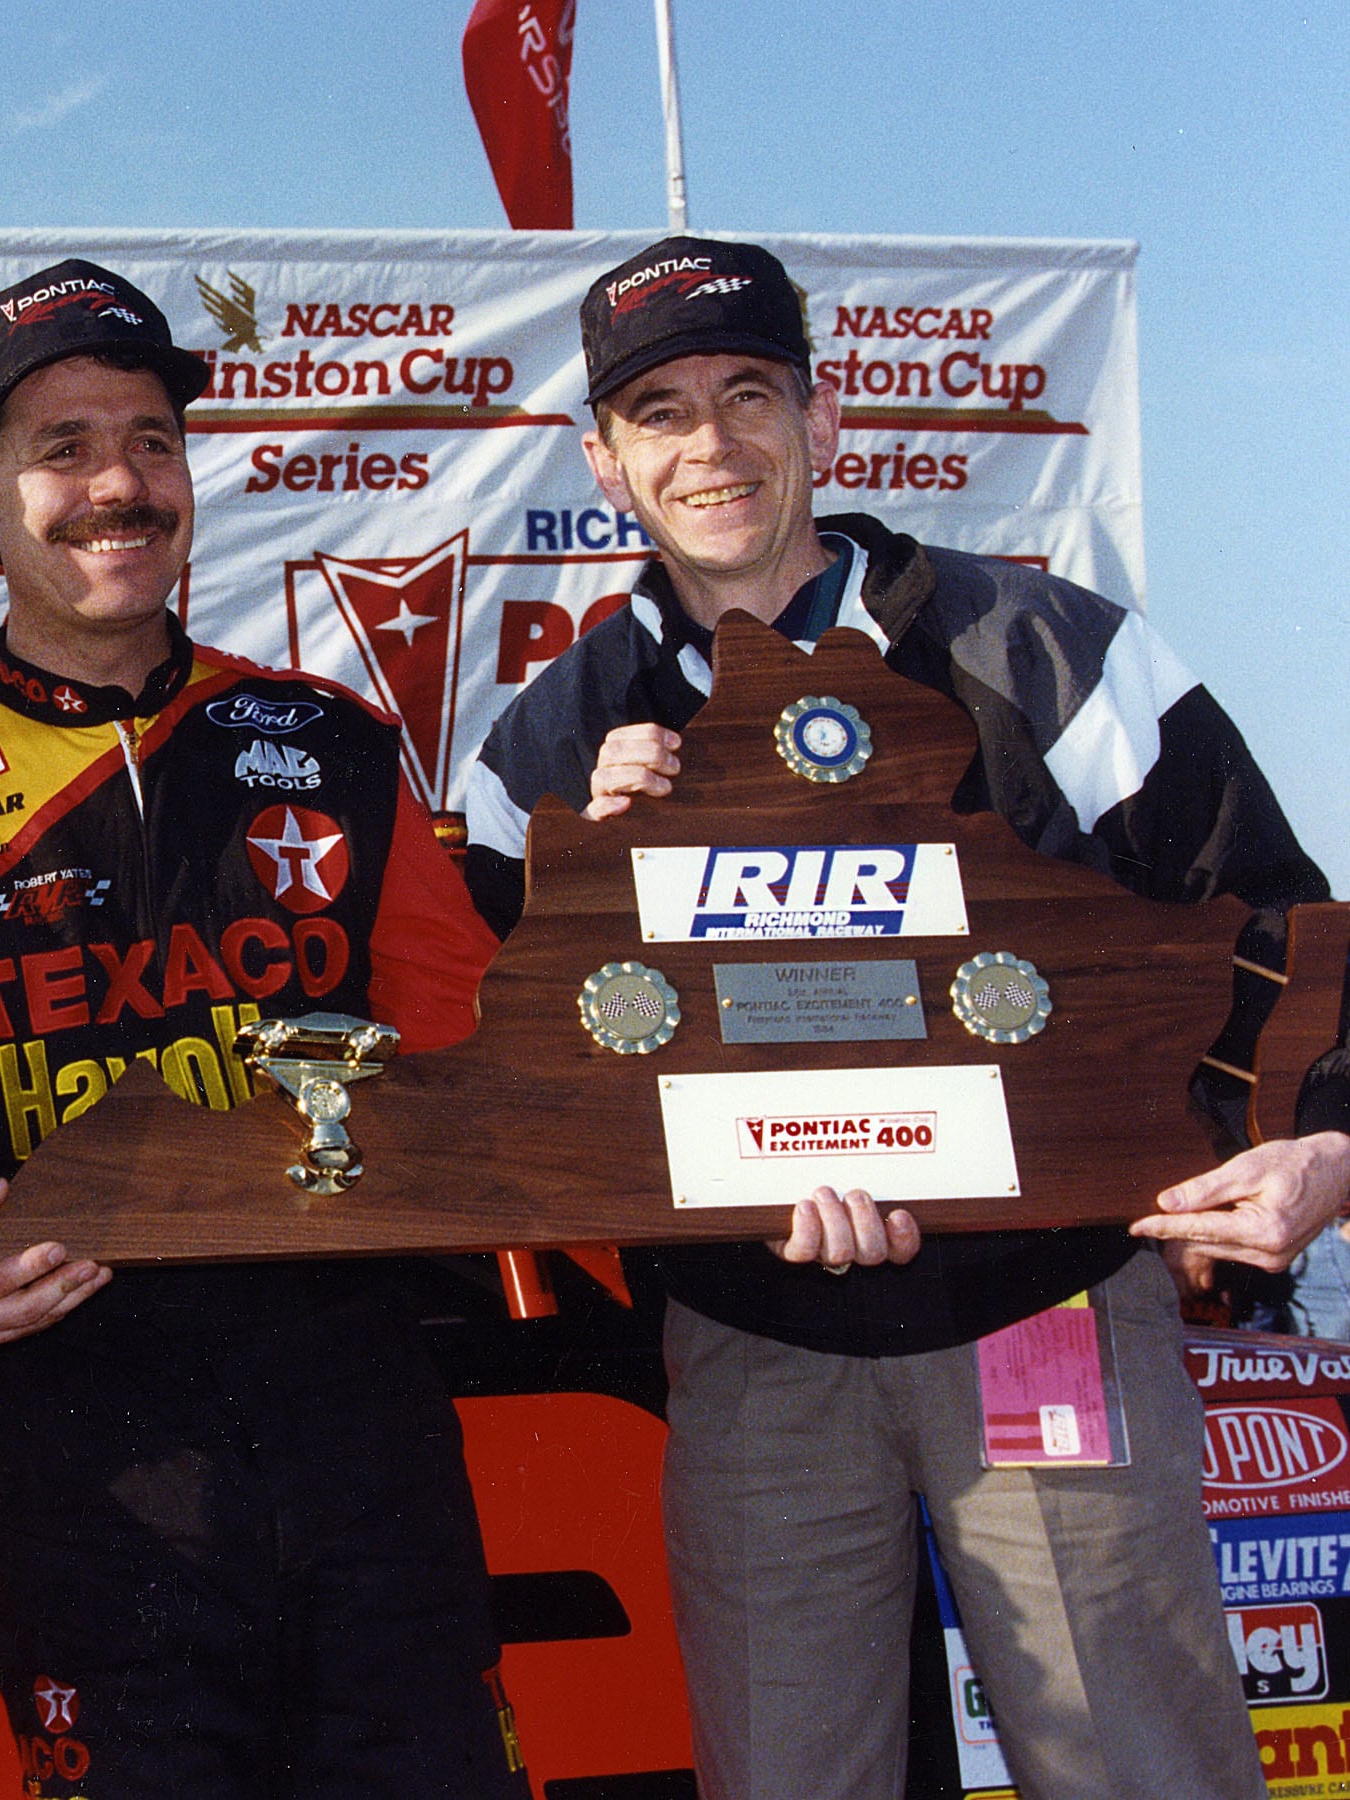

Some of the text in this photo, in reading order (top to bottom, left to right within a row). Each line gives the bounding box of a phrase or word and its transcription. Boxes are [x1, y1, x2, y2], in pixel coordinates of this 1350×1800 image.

[617, 257, 712, 296] PONTIAC
[17, 279, 115, 312] PONTIAC
[281, 304, 455, 337] NASCAR
[833, 305, 993, 340] NASCAR
[198, 348, 514, 407] inston Cup
[816, 350, 1047, 411] ston Cup
[245, 443, 430, 493] Series
[228, 696, 300, 728] Ford
[234, 739, 322, 779] MAC
[239, 773, 323, 790] TOOLS
[13, 871, 58, 890] ROBERT
[705, 849, 906, 908] RIR
[705, 924, 885, 939] INTERNATIONAL RACEWAY
[744, 910, 852, 928] RICHMOND
[774, 967, 857, 982] WINNER
[769, 1118, 933, 1148] PONTIAC 400
[769, 1138, 871, 1152] EXCITEMENT
[1188, 1348, 1293, 1387] True
[1210, 1528, 1338, 1585] LEVITE
[1261, 1579, 1336, 1599] BEARINGS
